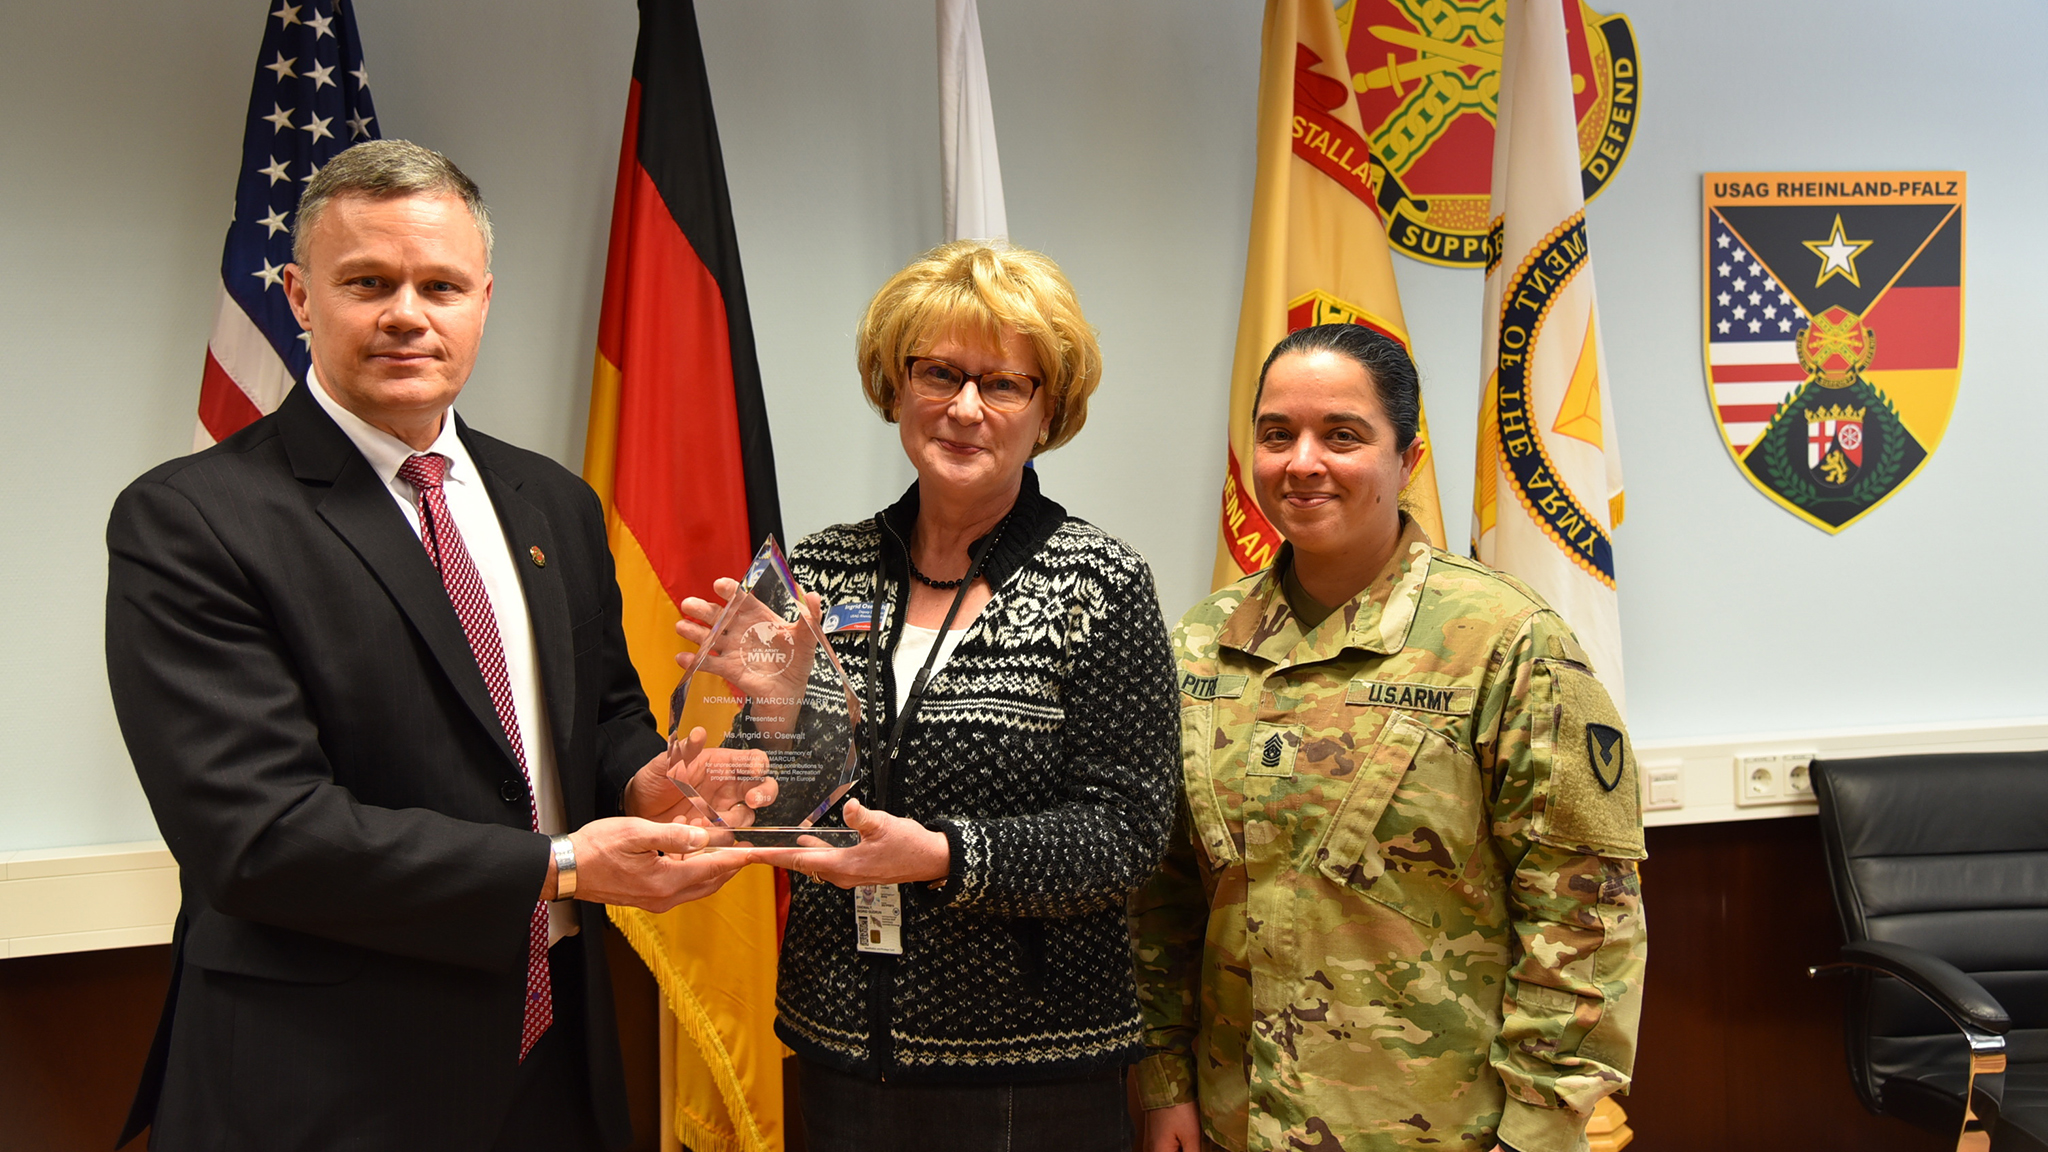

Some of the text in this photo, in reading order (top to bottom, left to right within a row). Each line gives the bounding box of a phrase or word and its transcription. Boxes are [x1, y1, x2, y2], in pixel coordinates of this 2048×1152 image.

[1588, 57, 1634, 181] DEFEND
[1292, 116, 1372, 189] STALLA
[1714, 182, 1958, 198] USAG RHEINLAND-PFALZ
[747, 652, 786, 663] MWR
[703, 696, 829, 706] NORMAN H. MARCUS AWARD
[723, 731, 806, 740] Ms. Ingrid G. Osewalt
